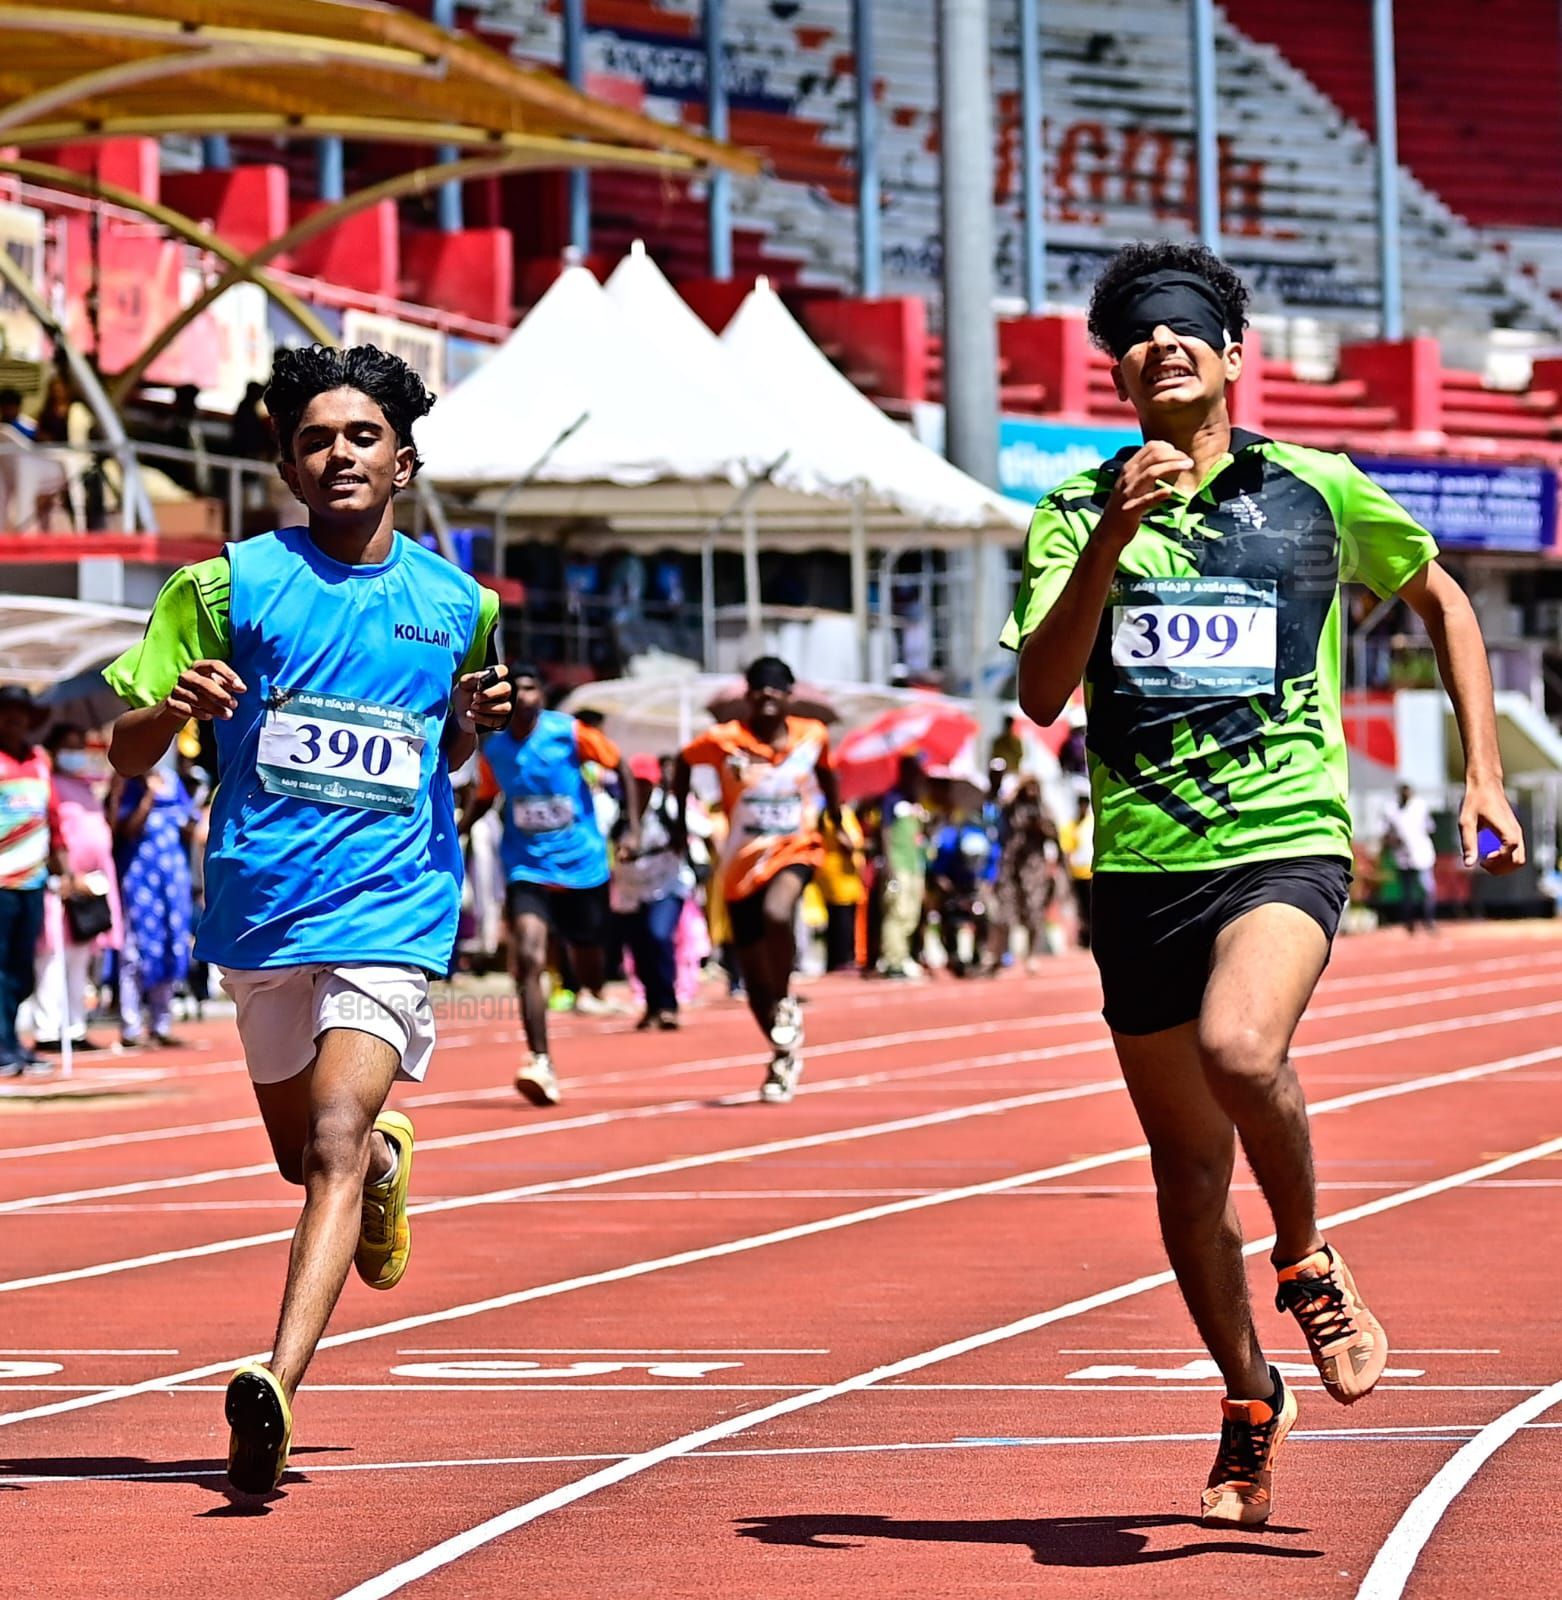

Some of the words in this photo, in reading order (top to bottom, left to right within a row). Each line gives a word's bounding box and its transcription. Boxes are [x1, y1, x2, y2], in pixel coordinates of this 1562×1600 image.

[394, 623, 450, 648] KOLLAM
[1131, 613, 1238, 659] 399
[299, 694, 324, 708] കേരള
[290, 724, 392, 776] 390
